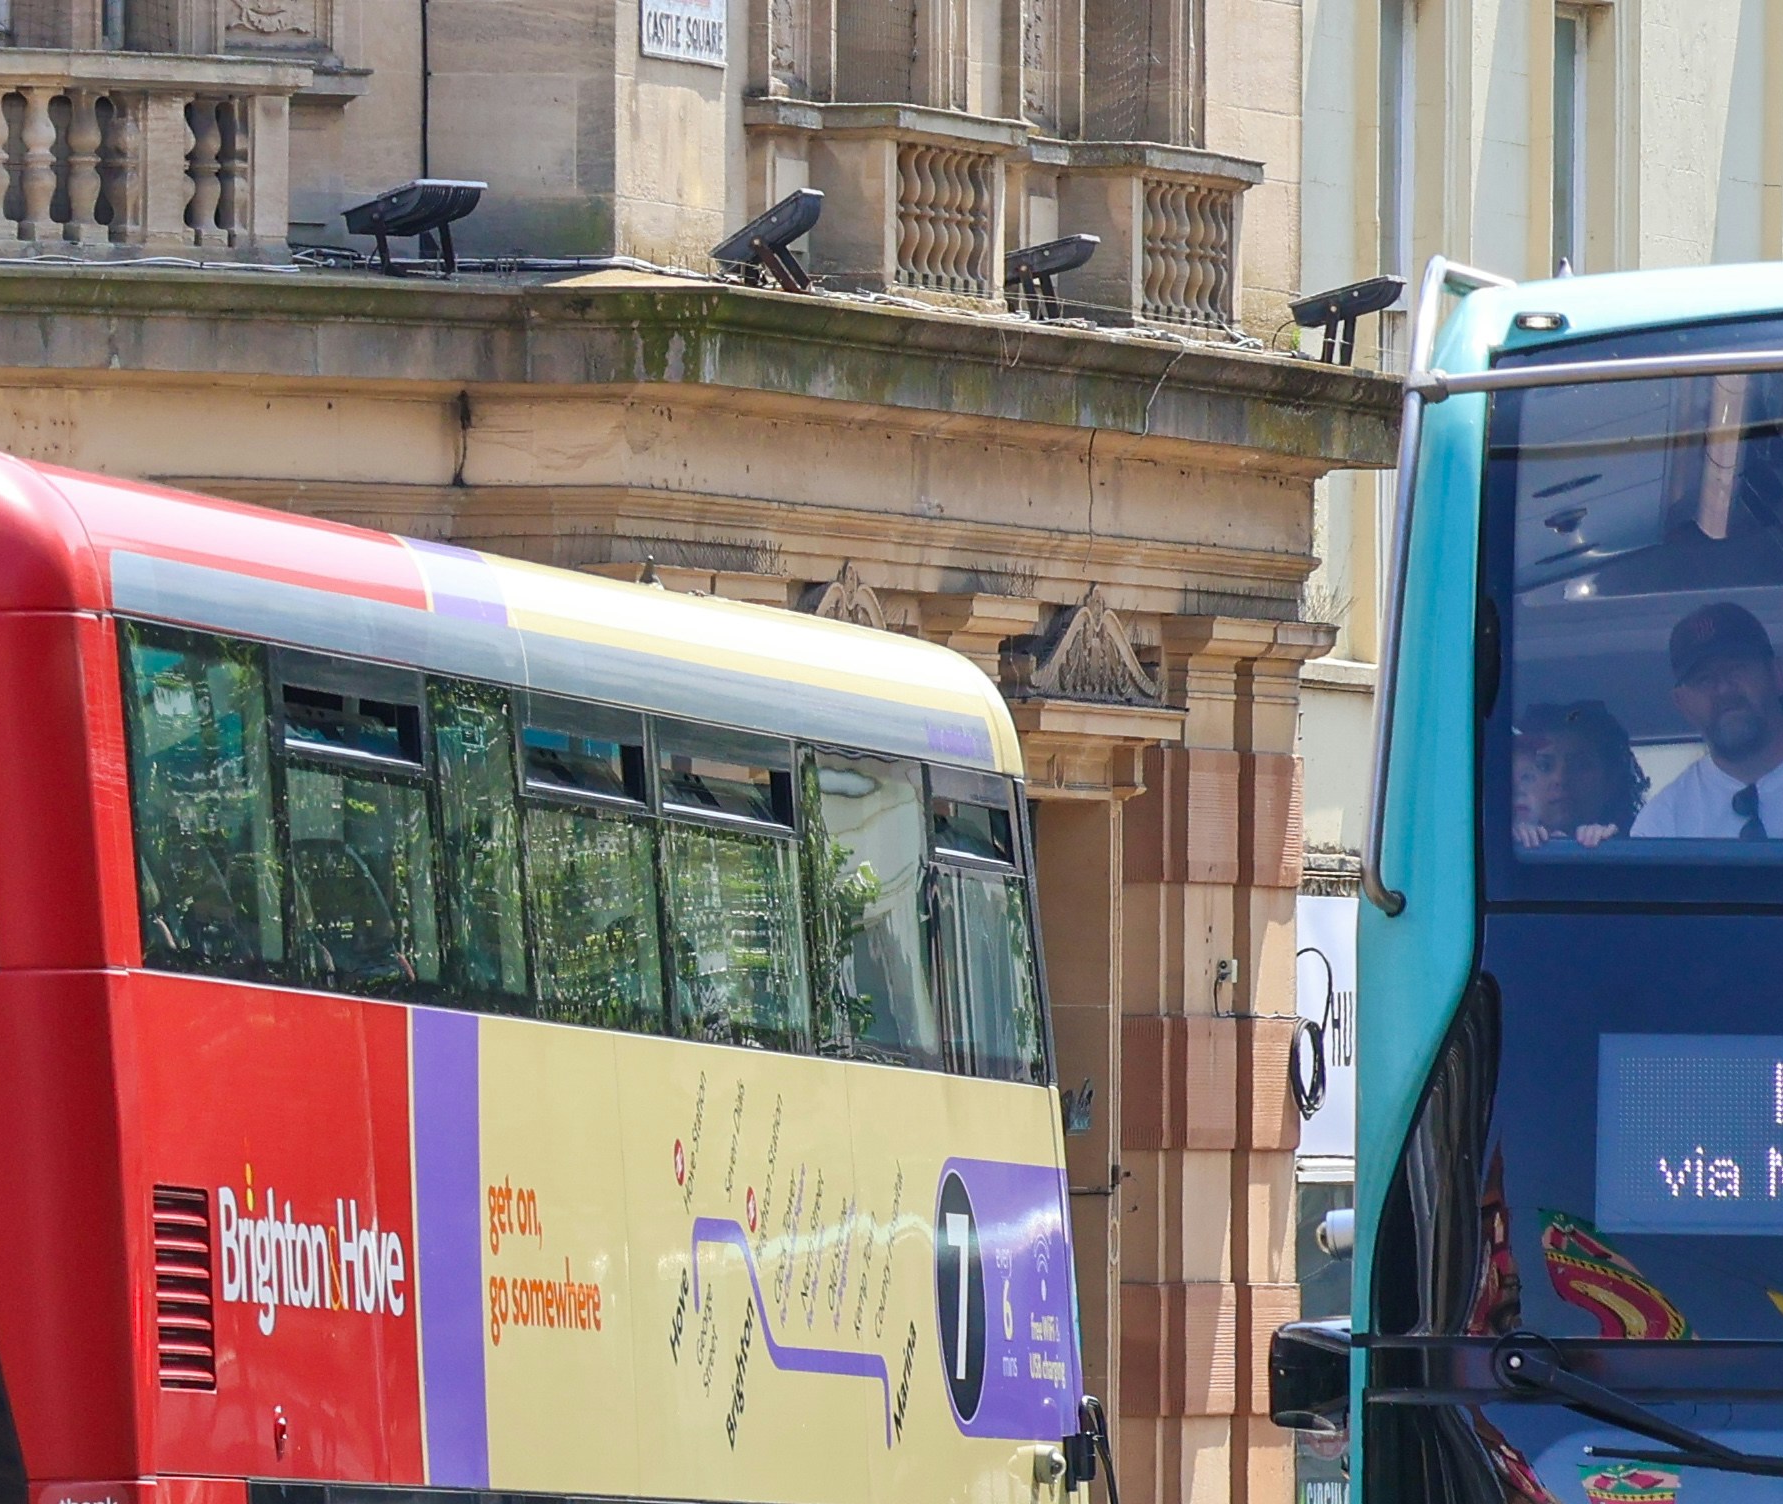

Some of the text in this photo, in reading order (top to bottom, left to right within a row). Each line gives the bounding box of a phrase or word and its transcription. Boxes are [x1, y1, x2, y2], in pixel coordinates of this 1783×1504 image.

[646, 10, 724, 56] CASTLE SQUARE
[488, 1175, 543, 1256] get on,
[1658, 1146, 1741, 1199] via
[489, 1257, 602, 1347] go somewhere
[669, 1267, 689, 1367] Hove
[945, 1212, 969, 1380] 7
[726, 1297, 754, 1451] Brighton
[893, 1320, 917, 1443] Marina
